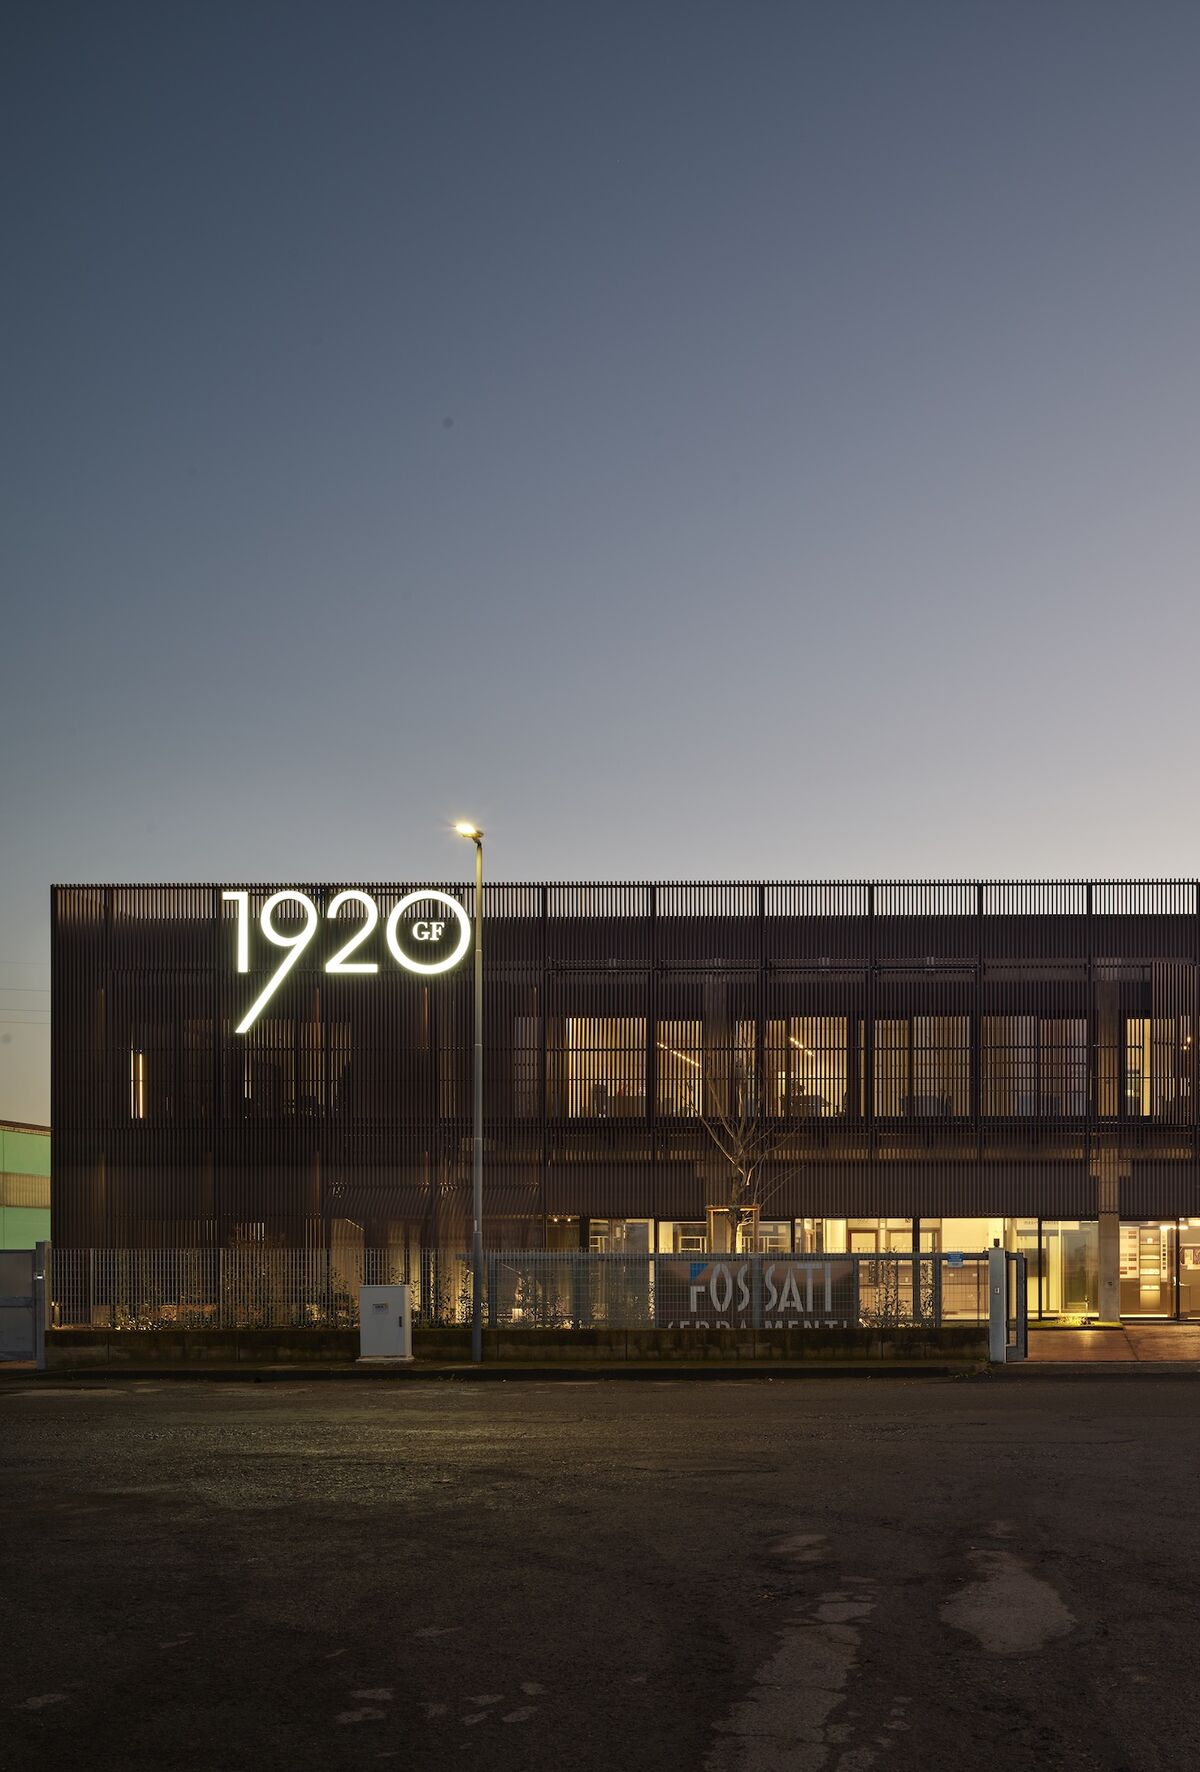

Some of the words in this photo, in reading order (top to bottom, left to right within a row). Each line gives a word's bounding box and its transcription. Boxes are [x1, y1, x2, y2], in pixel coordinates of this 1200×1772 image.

[412, 921, 445, 941] GF
[222, 890, 471, 1034] 1920
[690, 1263, 832, 1313] FOSSATI
